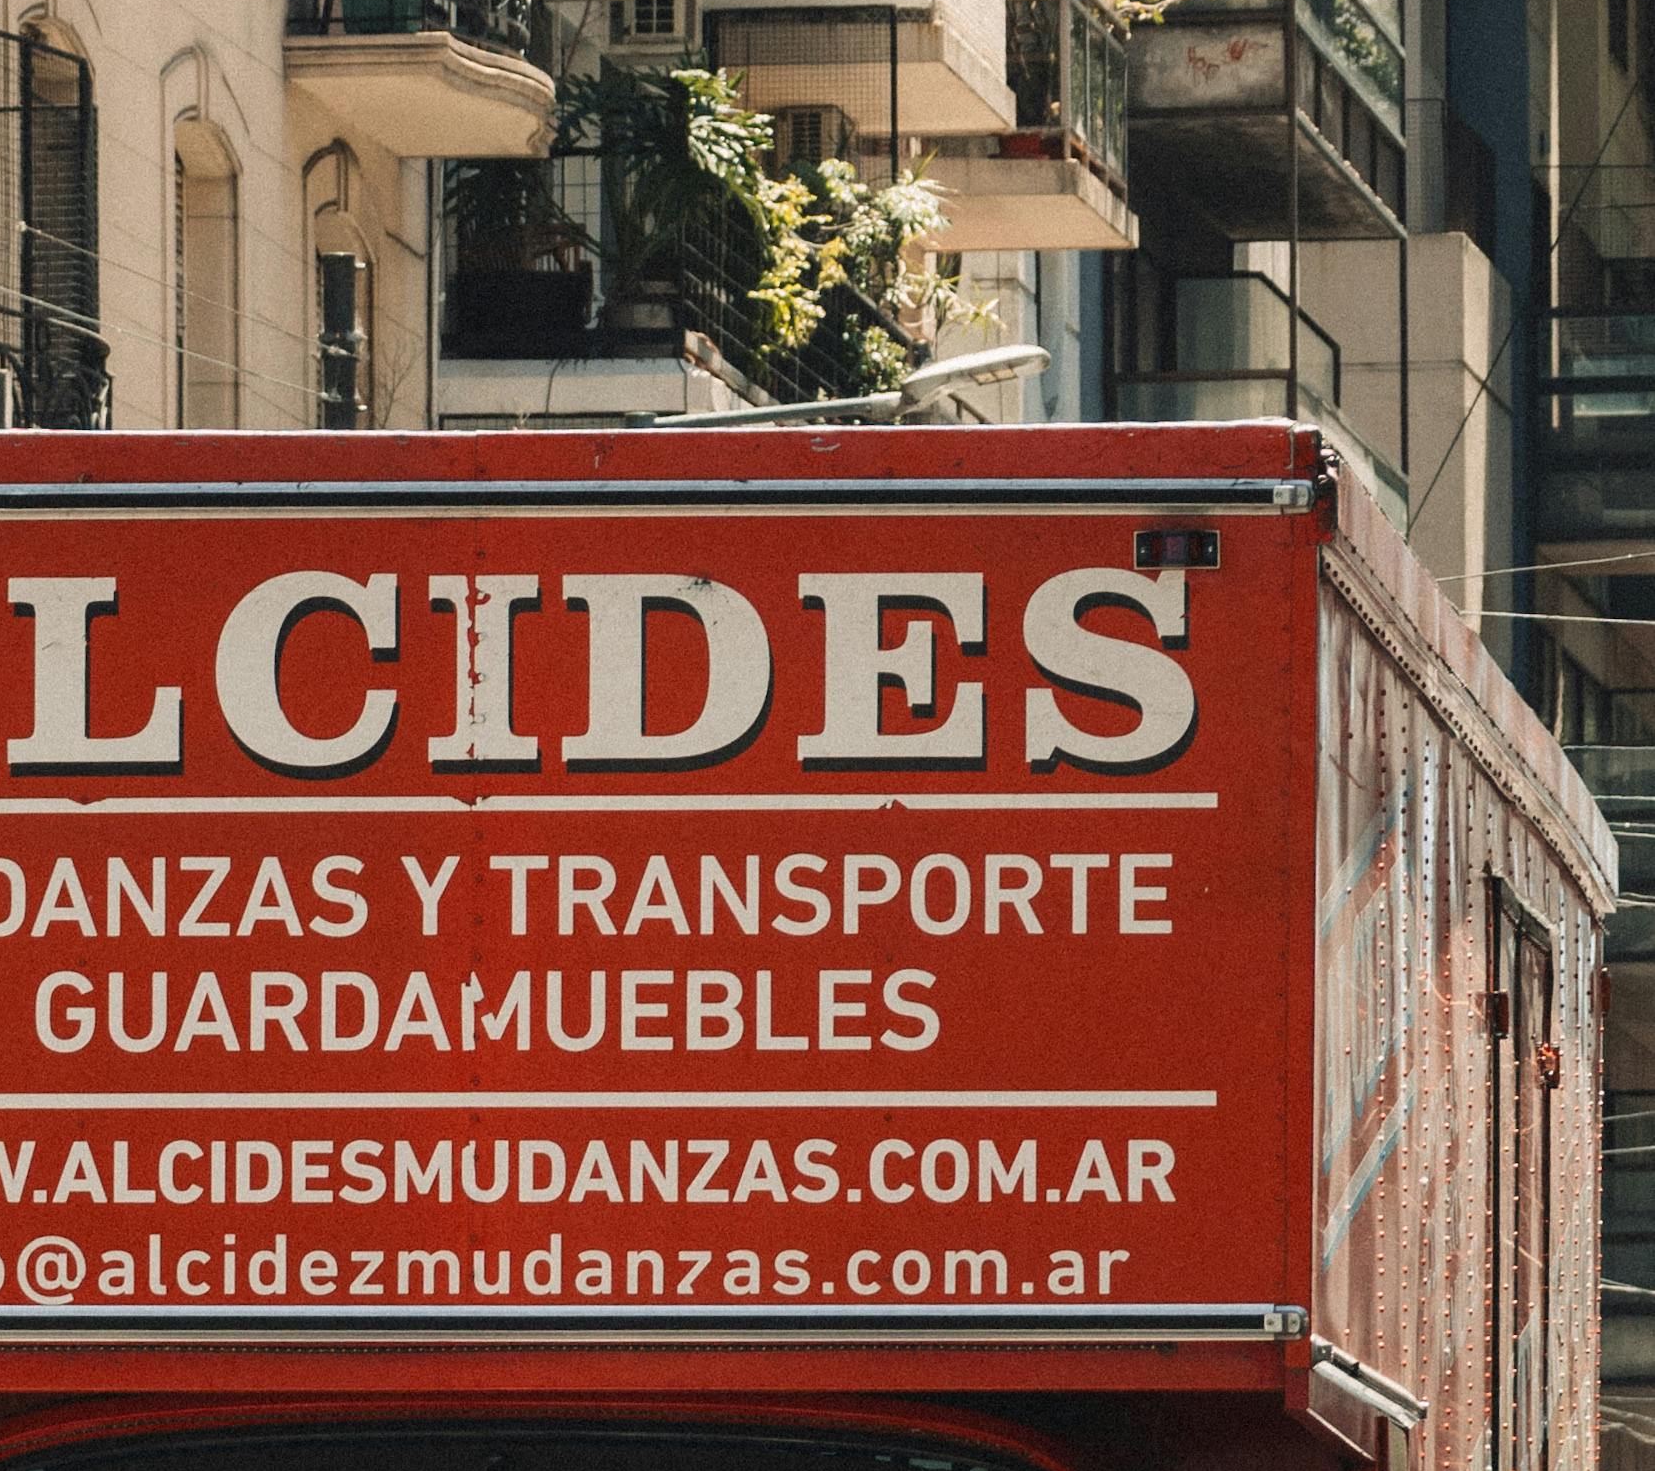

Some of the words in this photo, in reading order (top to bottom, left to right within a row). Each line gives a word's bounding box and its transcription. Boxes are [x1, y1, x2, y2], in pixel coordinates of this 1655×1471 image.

[401, 855, 461, 937] Y
[490, 853, 1174, 937] TRANSPORTE
[35, 968, 941, 1054] GUARDAMUEBLES
